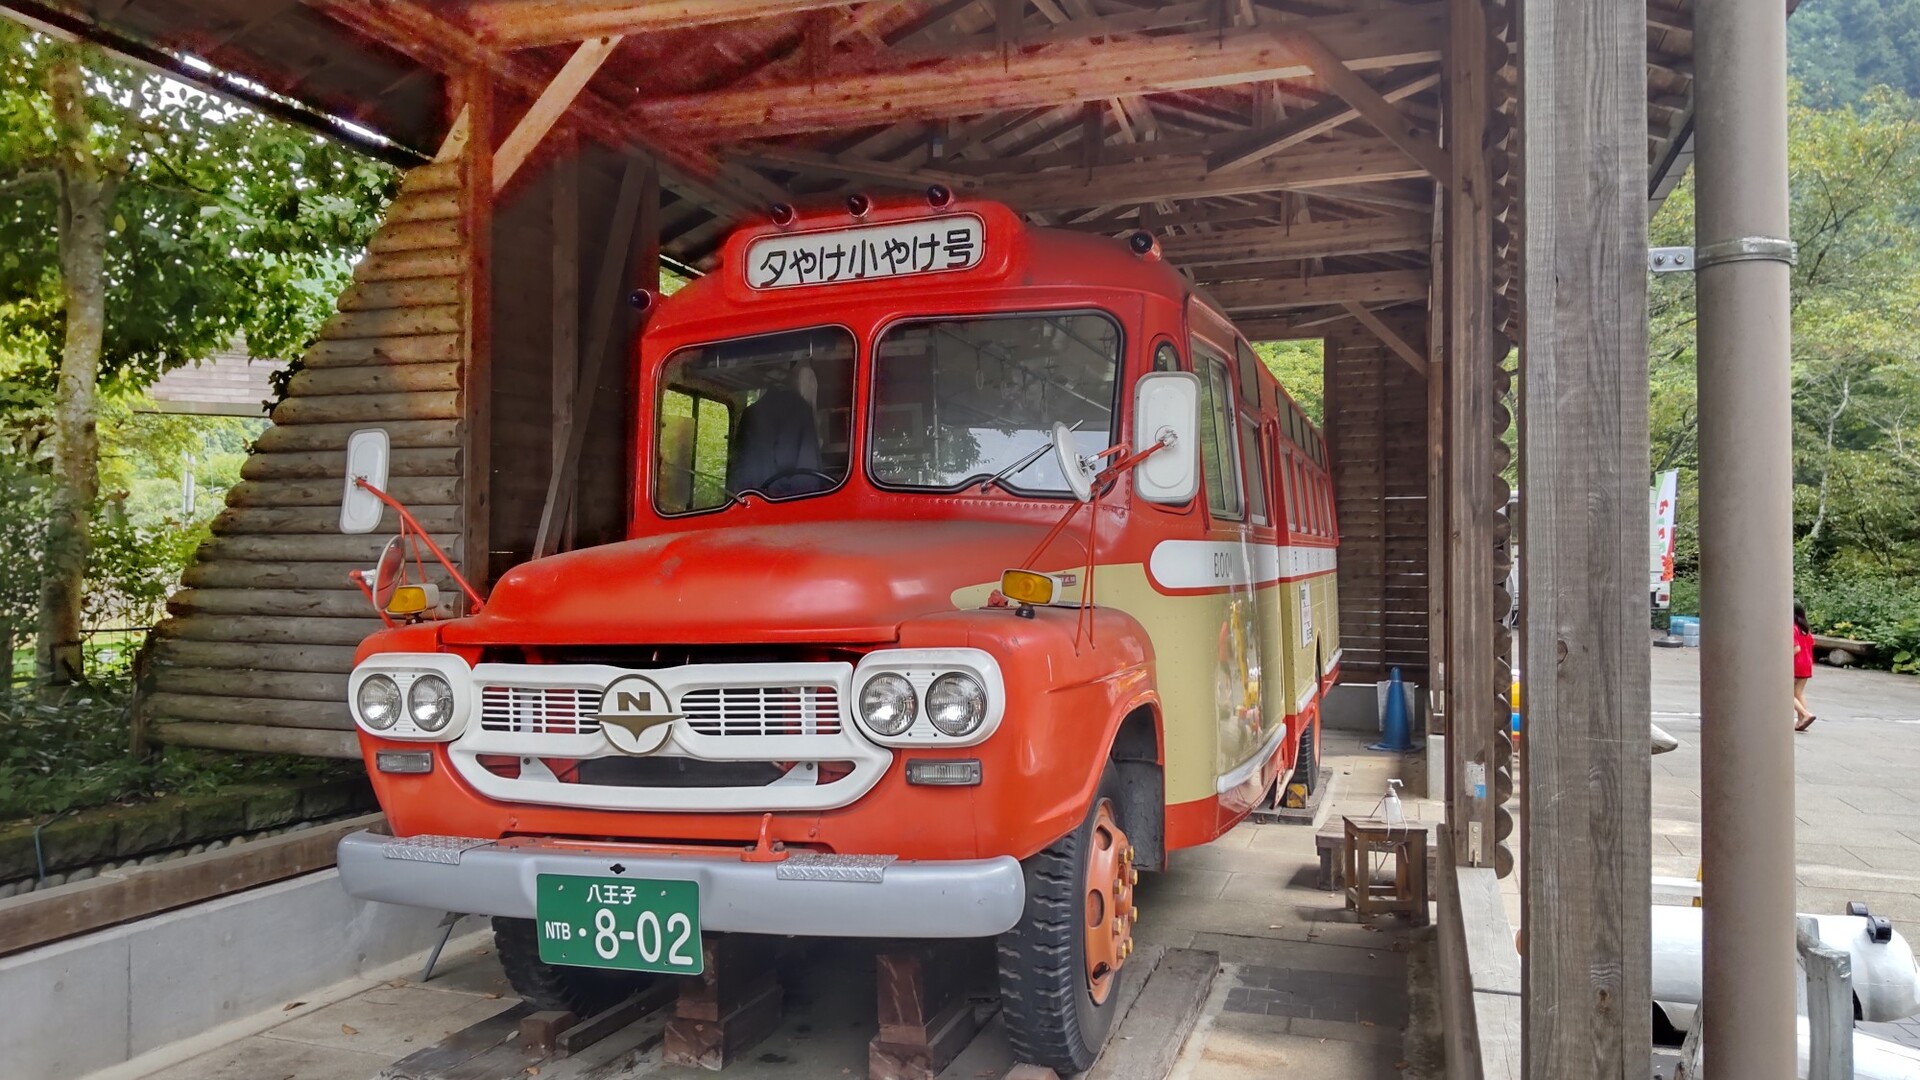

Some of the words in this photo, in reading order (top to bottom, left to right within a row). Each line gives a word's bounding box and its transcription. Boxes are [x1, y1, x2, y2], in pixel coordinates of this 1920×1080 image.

[760, 228, 974, 287] 夕やけ小やけ号
[616, 691, 652, 712] N
[586, 884, 637, 905] 八王子
[545, 921, 571, 940] NTB
